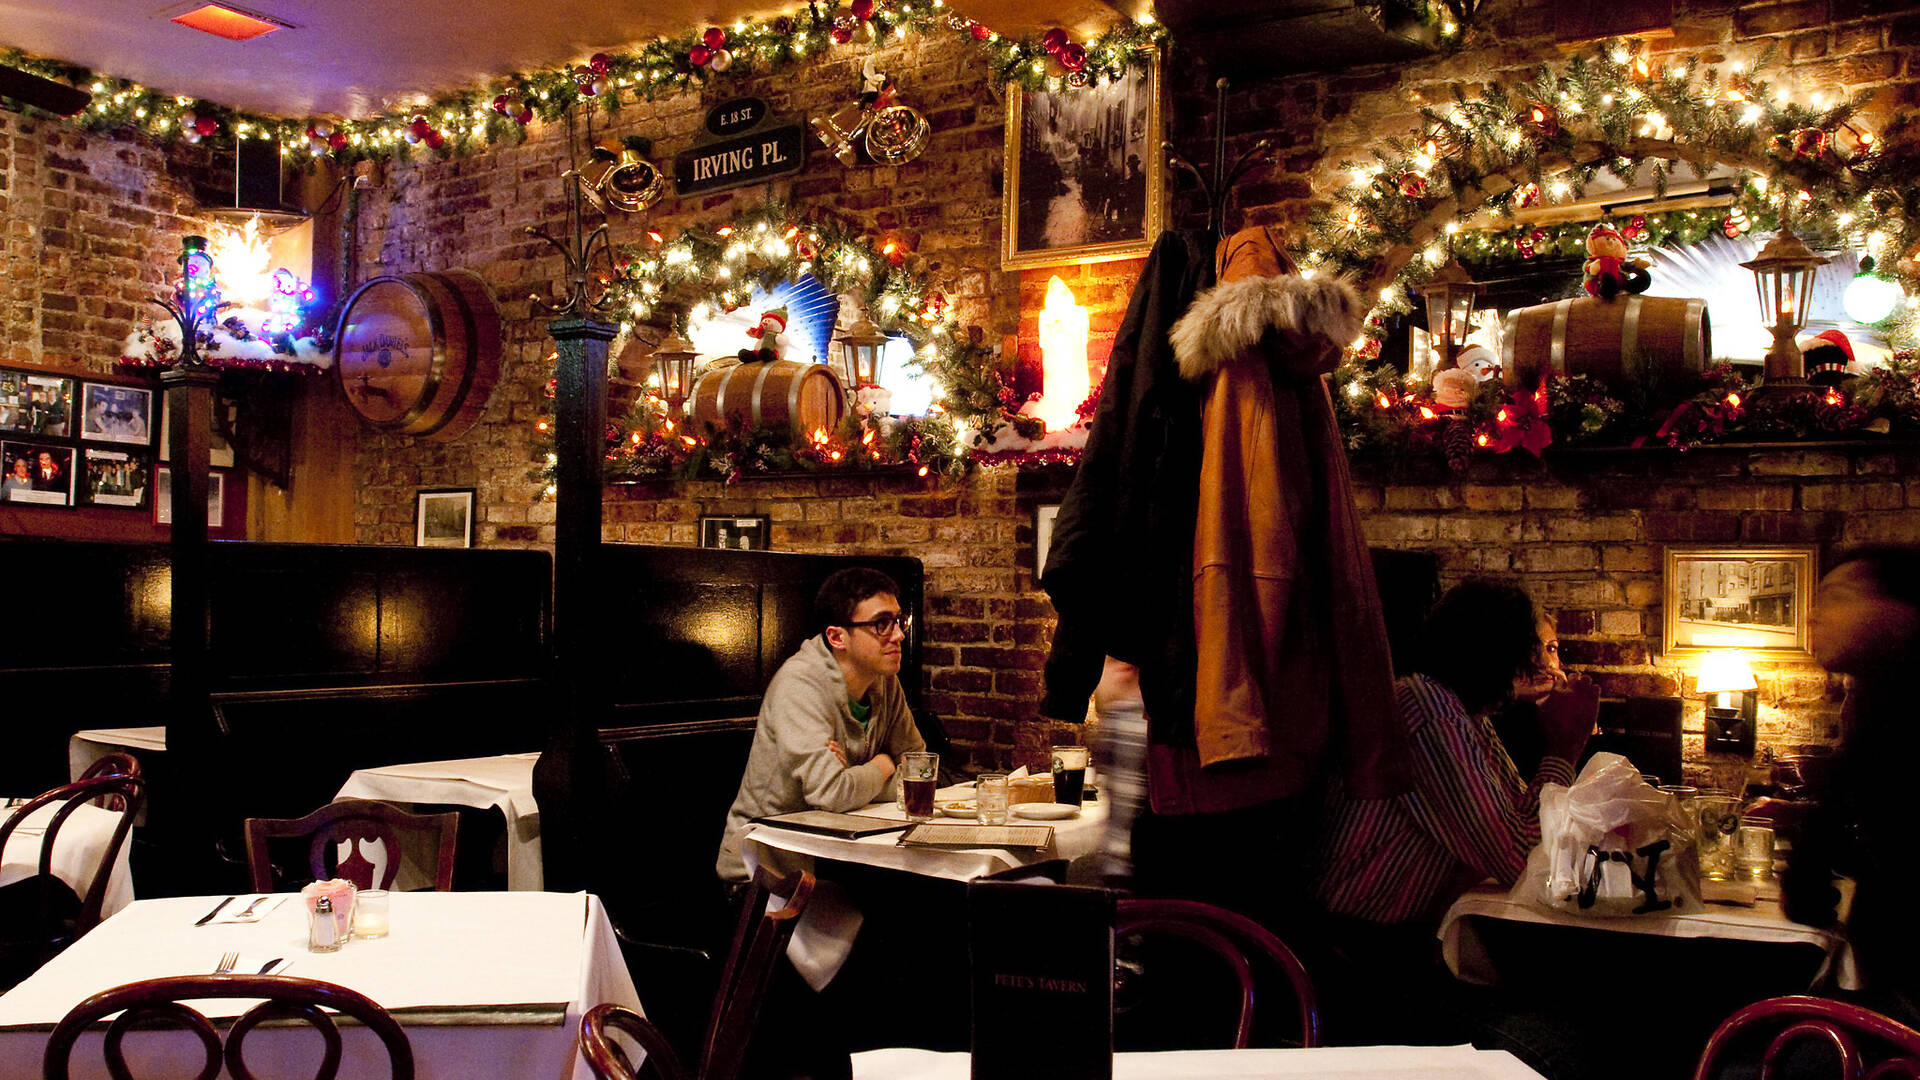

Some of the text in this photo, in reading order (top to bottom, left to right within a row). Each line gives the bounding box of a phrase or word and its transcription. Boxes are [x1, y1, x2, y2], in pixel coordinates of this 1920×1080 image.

[720, 107, 753, 126] E. 18 ST.
[693, 141, 787, 181] IRVING PL.
[994, 973, 1087, 992] PETE'S TAVERN
